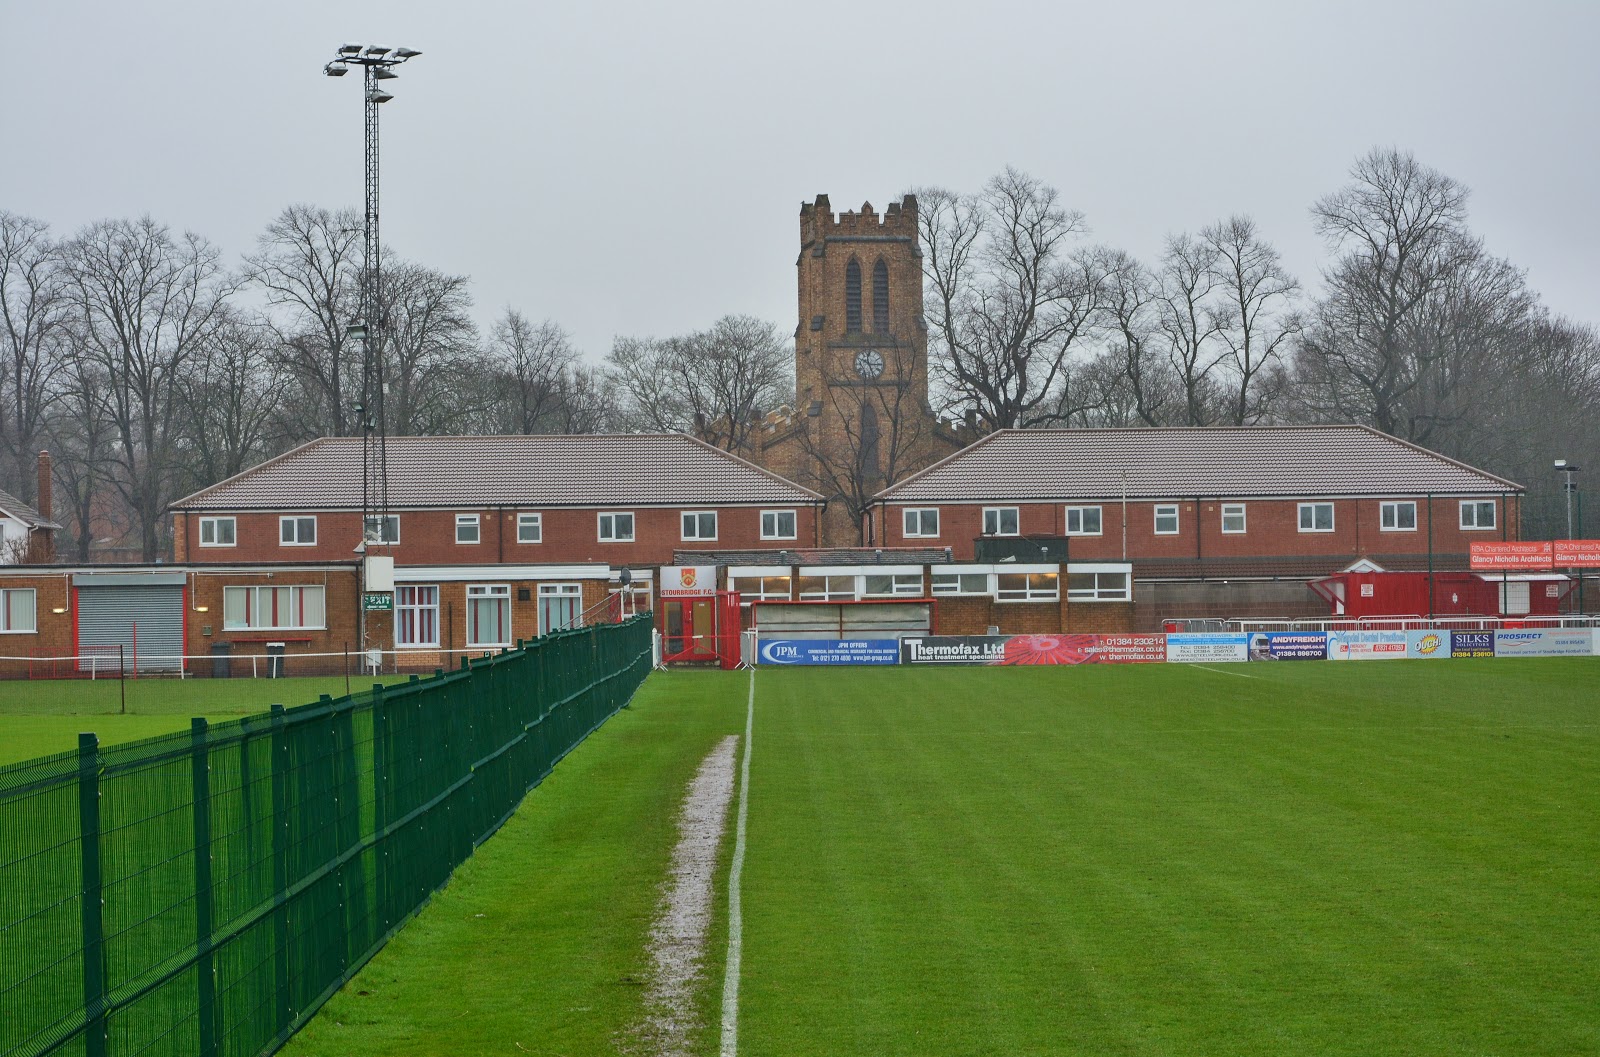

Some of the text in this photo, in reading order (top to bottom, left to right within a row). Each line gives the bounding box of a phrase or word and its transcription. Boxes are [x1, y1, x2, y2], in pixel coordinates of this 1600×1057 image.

[1472, 555, 1552, 564] Glancy Nicholls Architects
[1555, 553, 1577, 562] Glancy
[1455, 634, 1490, 643] SILKS
[904, 639, 1005, 660] Thermofax Ltd
[1415, 637, 1443, 652] OUCH!
[776, 646, 797, 657] JPM
